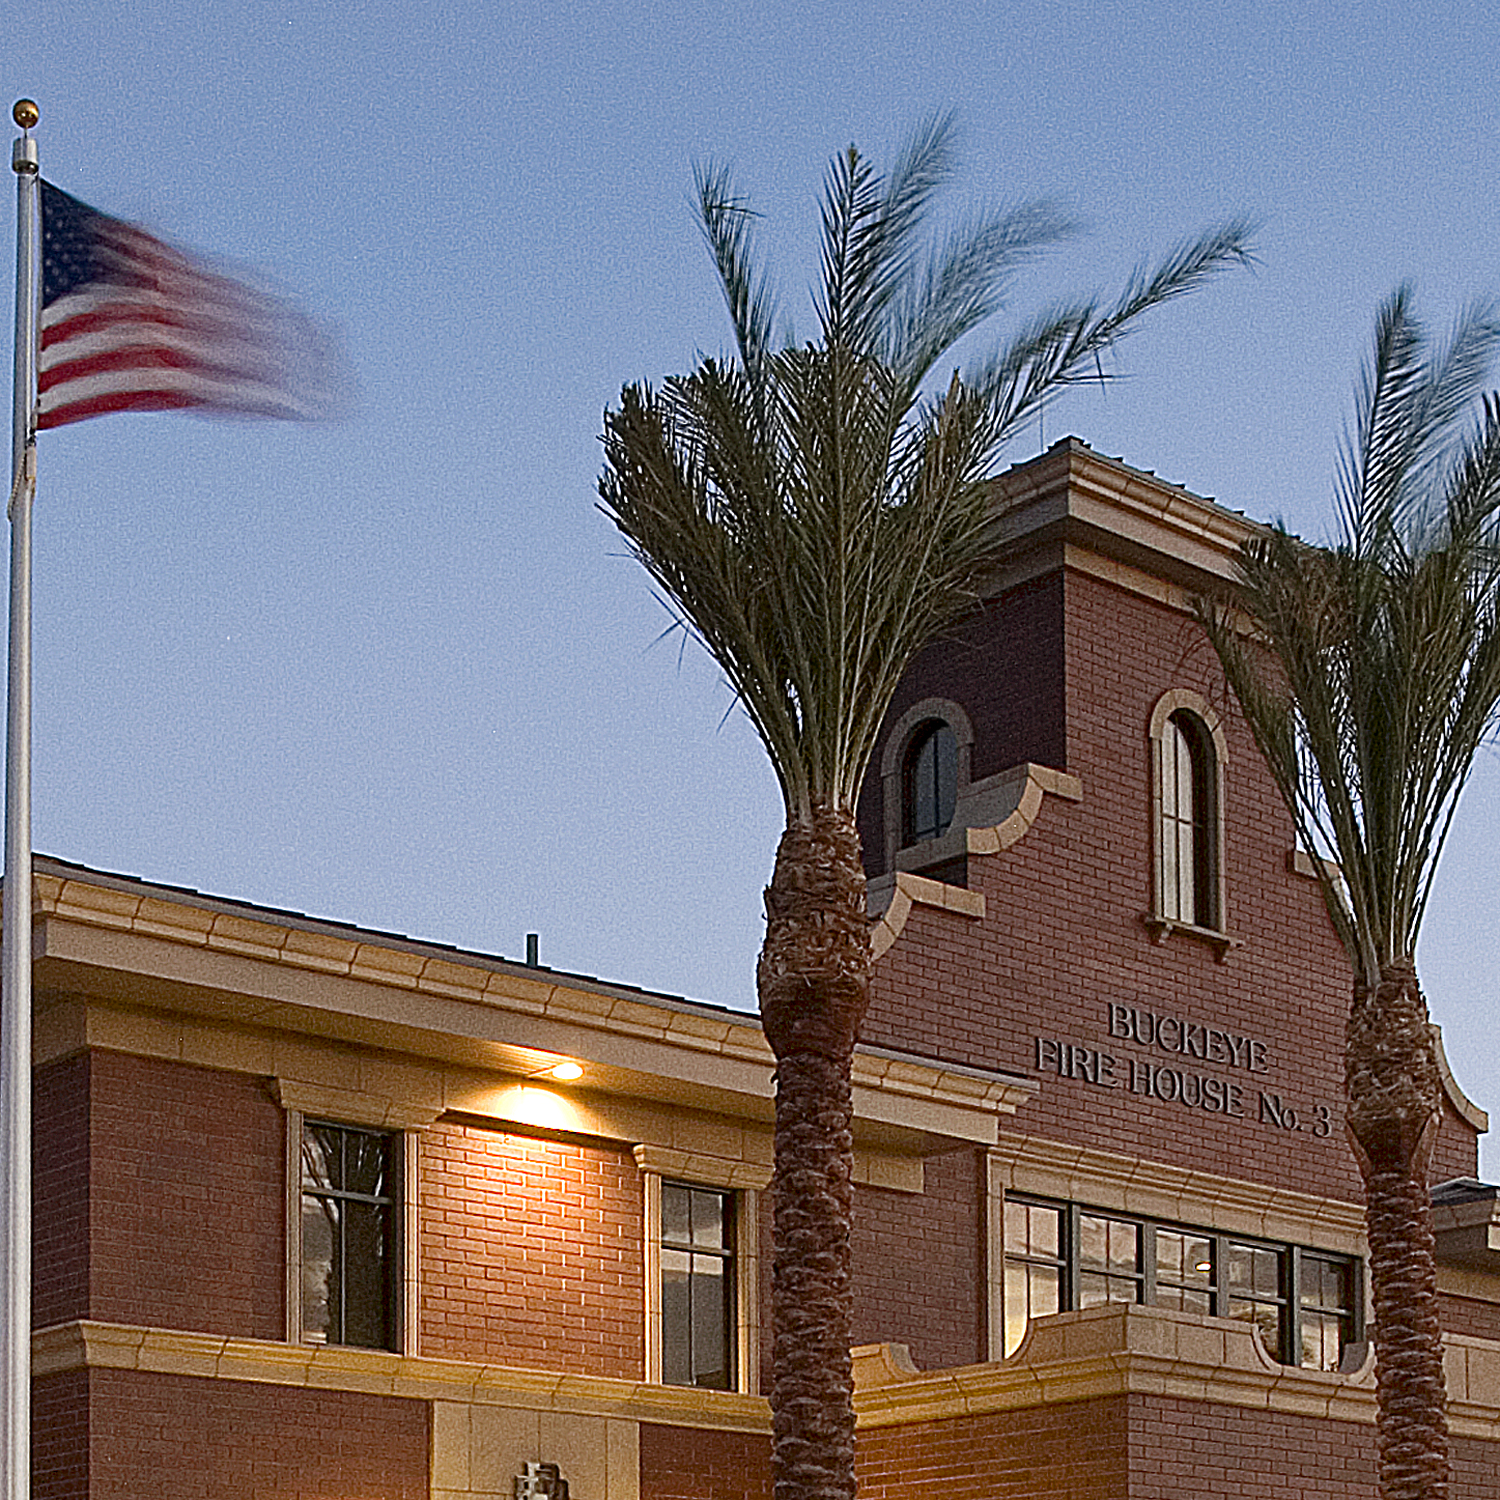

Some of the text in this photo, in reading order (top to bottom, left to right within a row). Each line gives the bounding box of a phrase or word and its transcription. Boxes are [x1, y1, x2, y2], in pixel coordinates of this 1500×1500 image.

[1107, 1002, 1269, 1075] BUCKEYE
[1035, 1037, 1331, 1138] FIRE HOUSE No. 3
